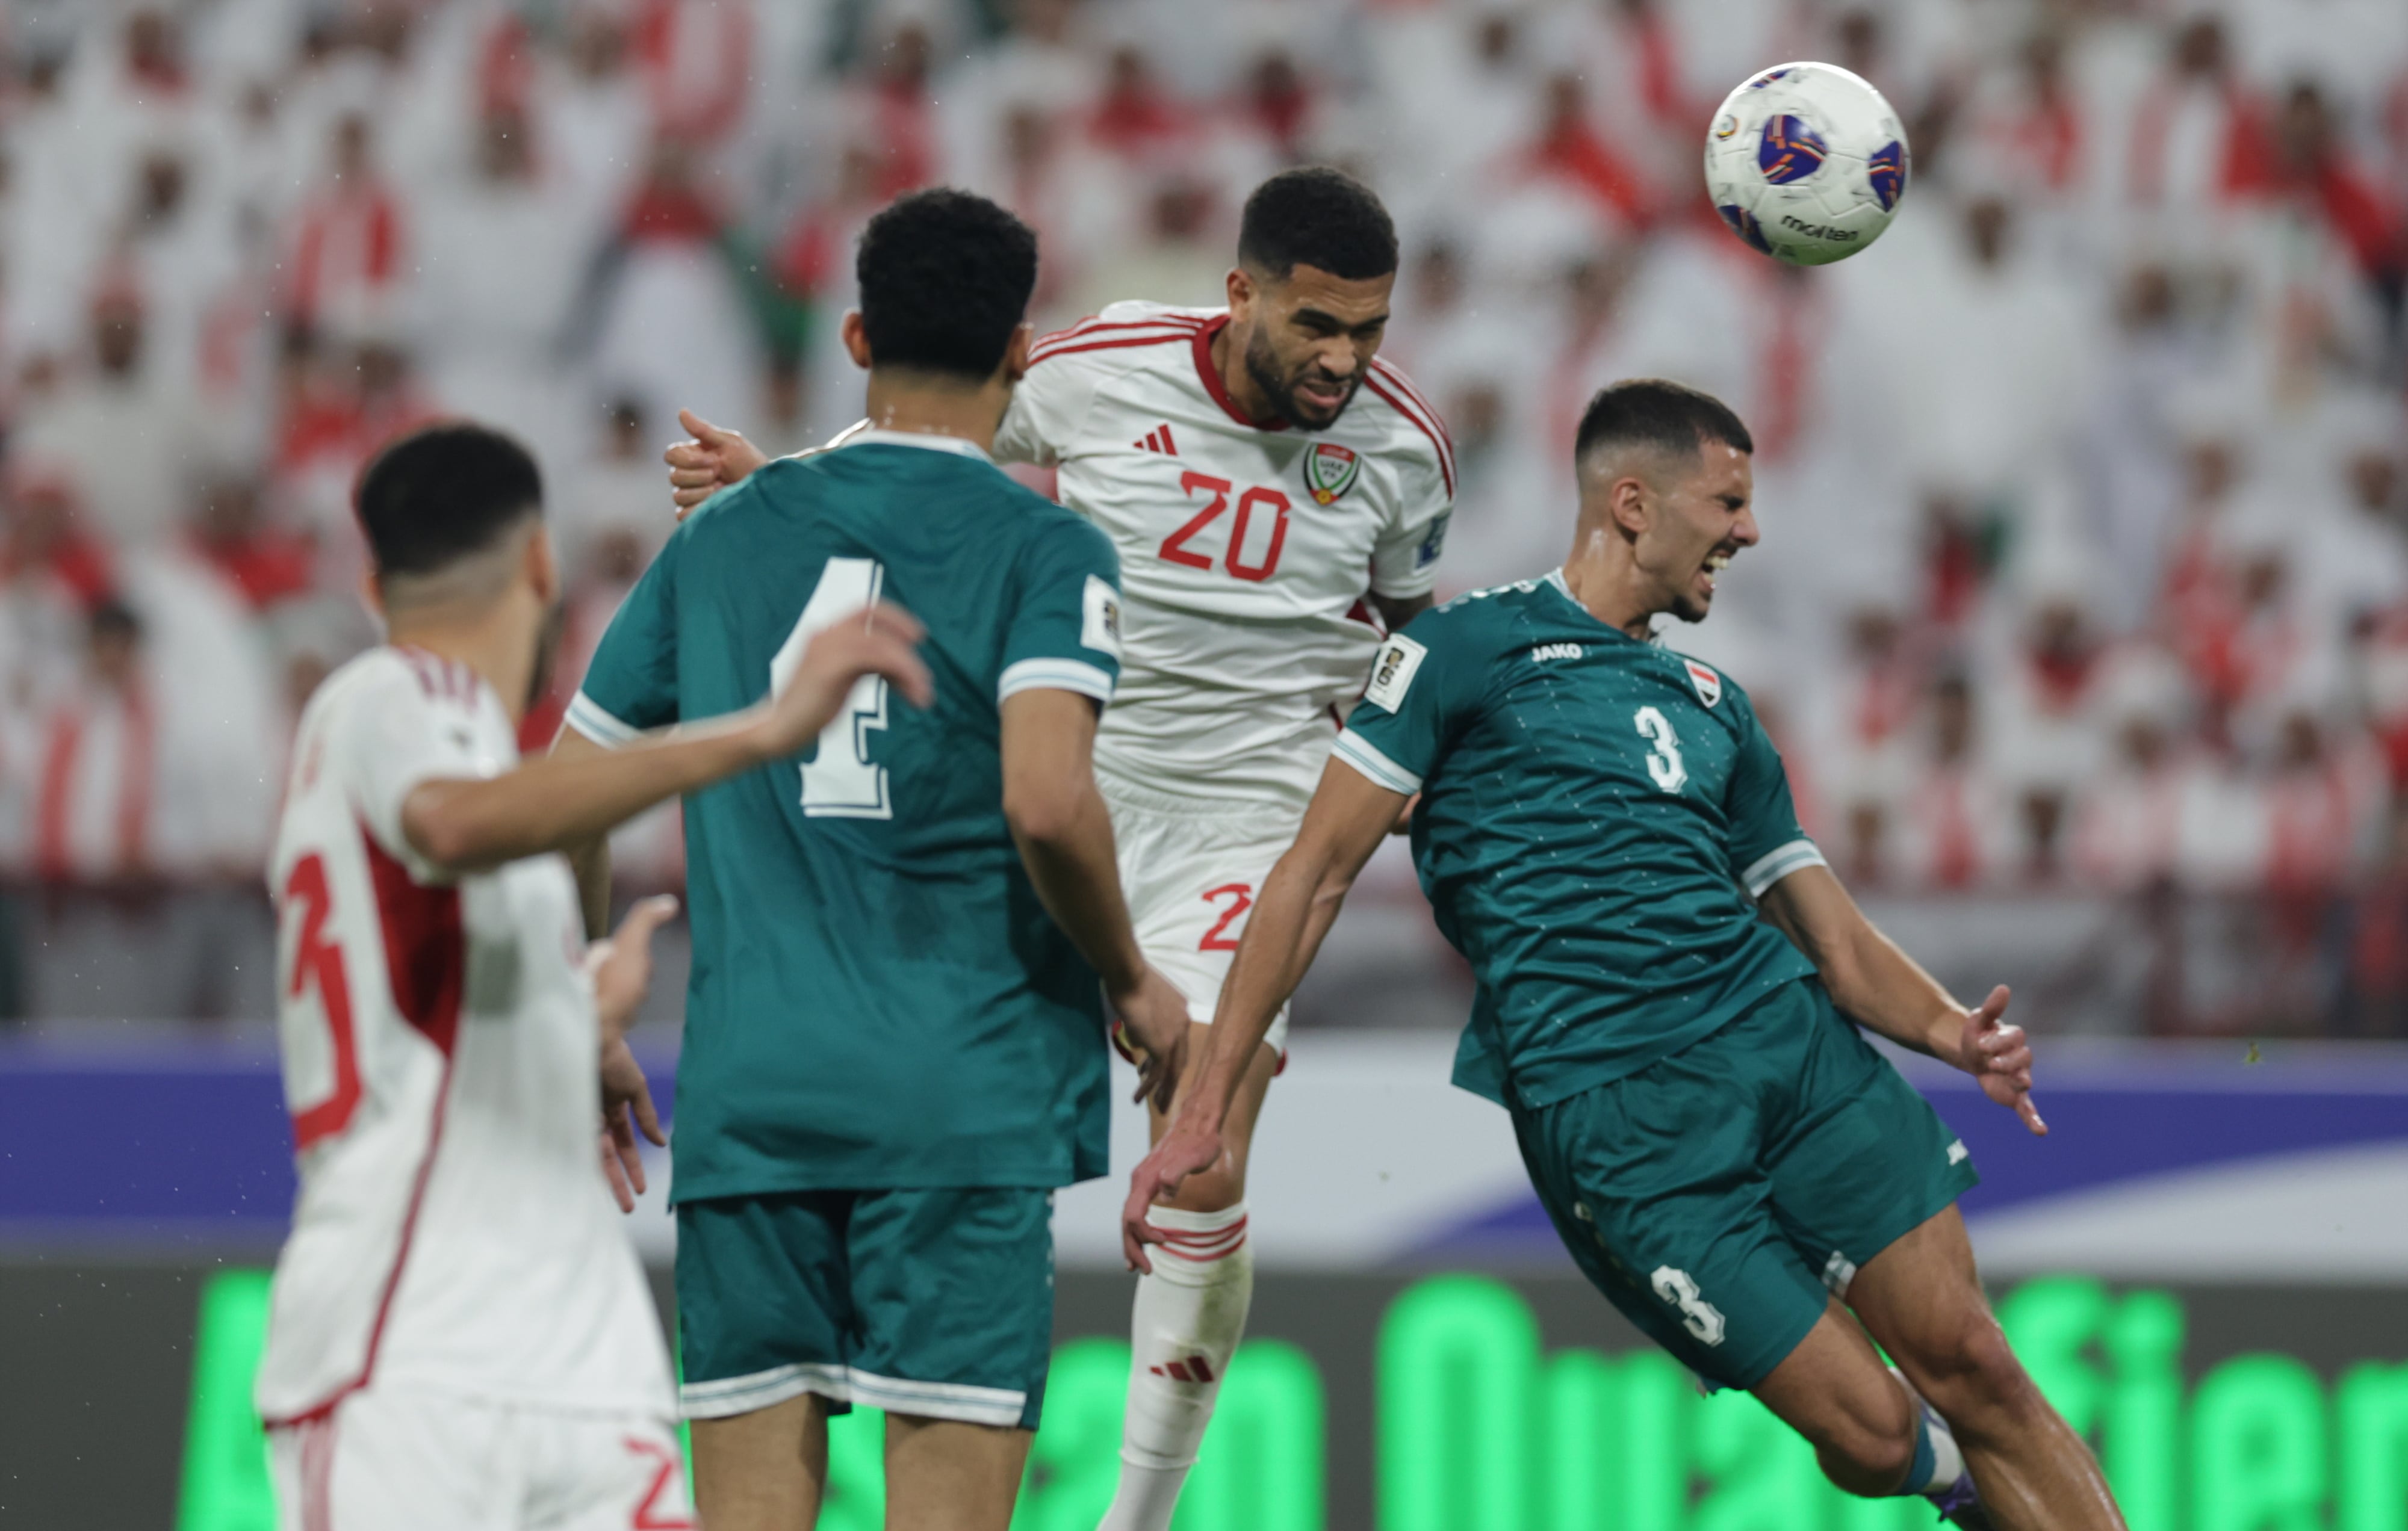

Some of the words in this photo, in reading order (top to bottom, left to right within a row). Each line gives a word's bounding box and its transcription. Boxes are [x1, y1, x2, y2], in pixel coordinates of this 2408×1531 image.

[1781, 215, 1859, 241] molten
[1158, 471, 1291, 582] 20
[1531, 642, 1583, 662] JAKO
[1633, 706, 1688, 794] 3
[1651, 1264, 1725, 1347] 3
